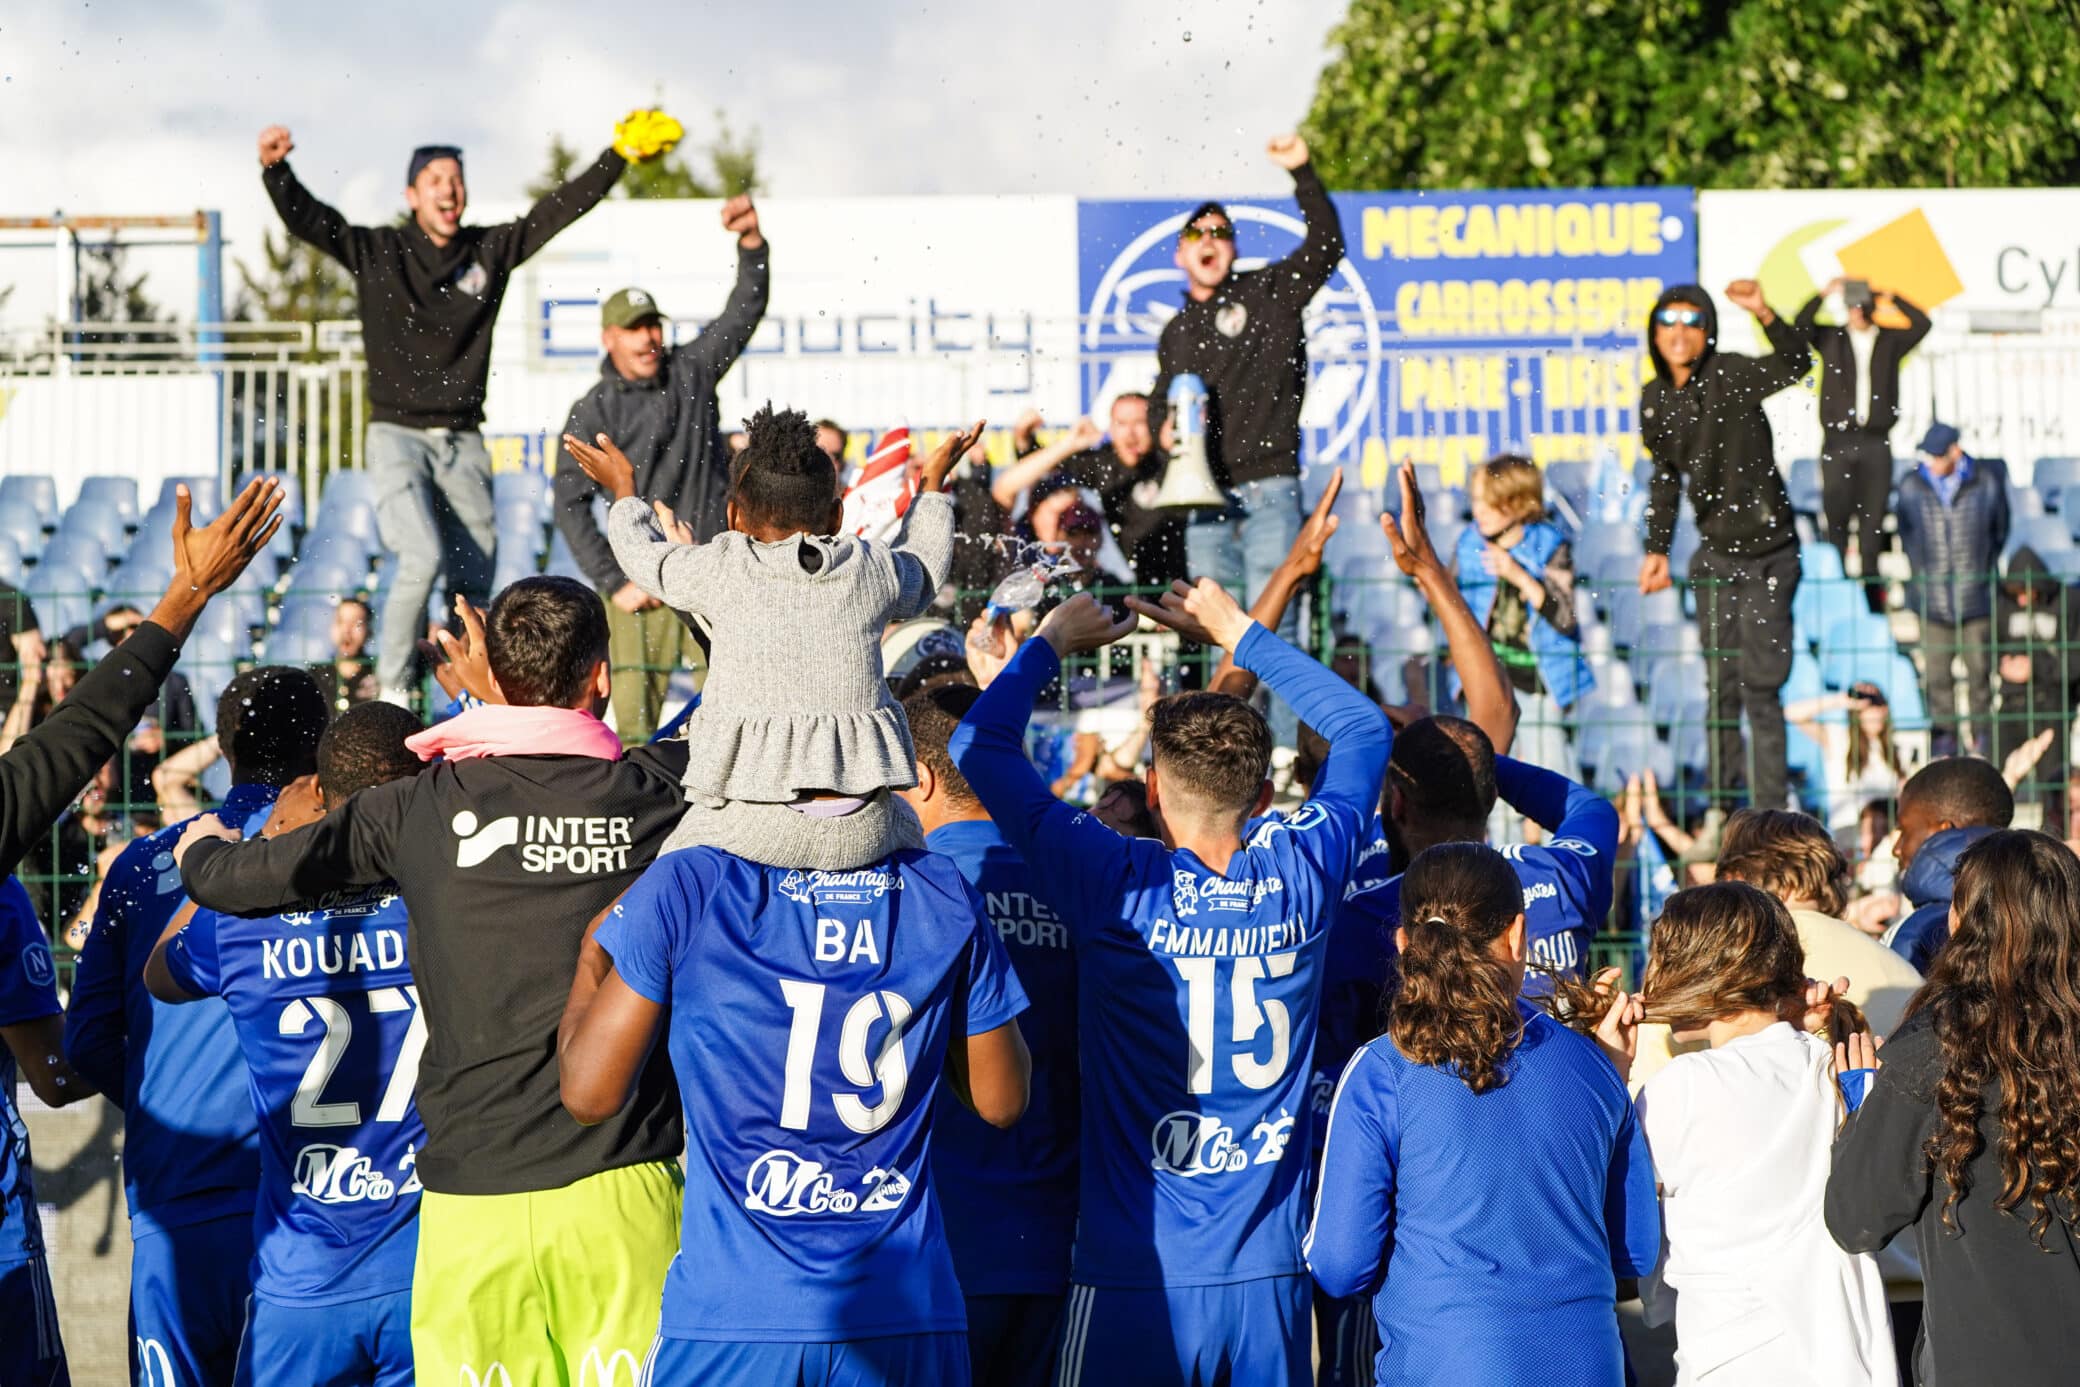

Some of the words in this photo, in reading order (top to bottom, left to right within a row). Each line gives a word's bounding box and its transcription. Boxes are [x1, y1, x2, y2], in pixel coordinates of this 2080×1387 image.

[1362, 202, 1664, 260] MECANIQUE
[1997, 245, 2080, 309] Cy
[525, 815, 632, 845] INTER
[521, 843, 632, 874] SPORT
[986, 892, 1059, 921] NTE
[815, 918, 880, 964] BA
[989, 917, 1068, 949] PORT
[1173, 951, 1297, 1095] 15
[279, 985, 429, 1127] 27
[779, 978, 913, 1134] 19
